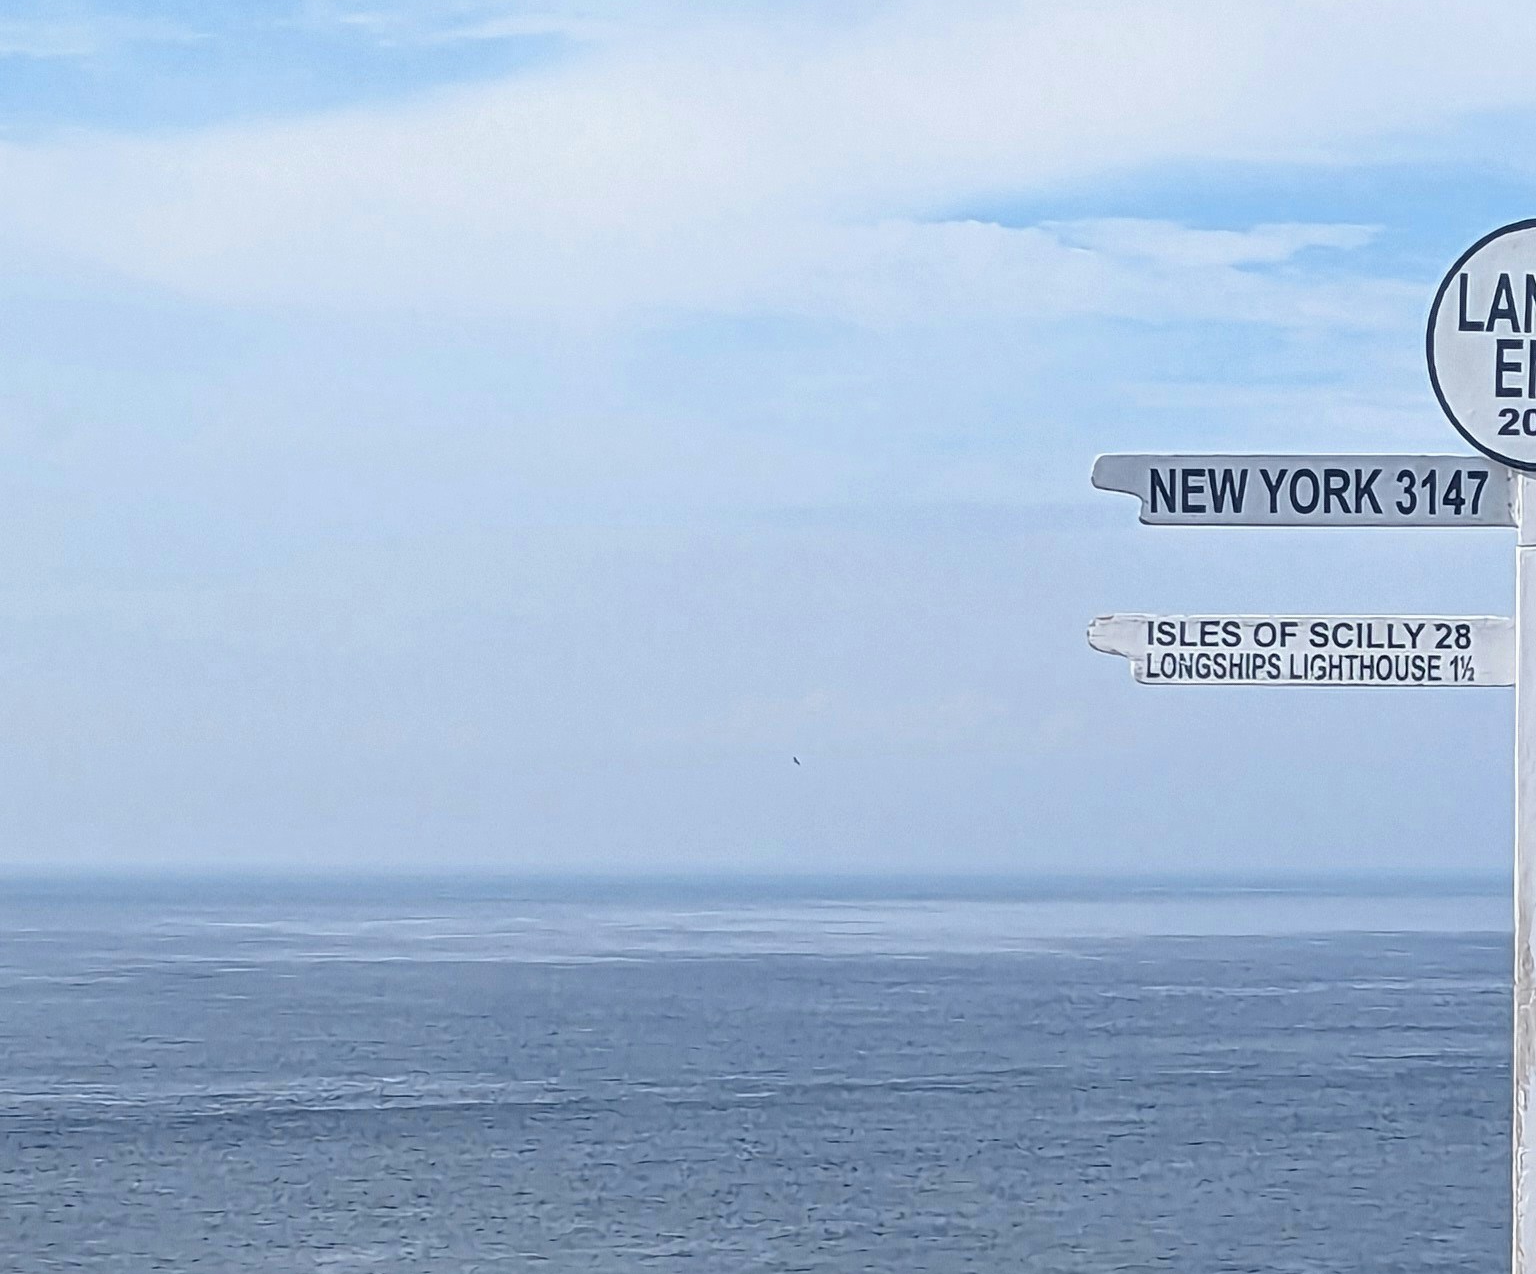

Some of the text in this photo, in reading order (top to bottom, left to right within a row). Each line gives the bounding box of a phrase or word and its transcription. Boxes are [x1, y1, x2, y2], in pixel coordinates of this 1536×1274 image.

[1149, 468, 1489, 515] NEW YORK 3147
[1147, 621, 1472, 649] ISLES OF SCILLY 28
[1146, 653, 1281, 680] LONGSHIPS
[1289, 654, 1442, 682] LIGHTHOUSE
